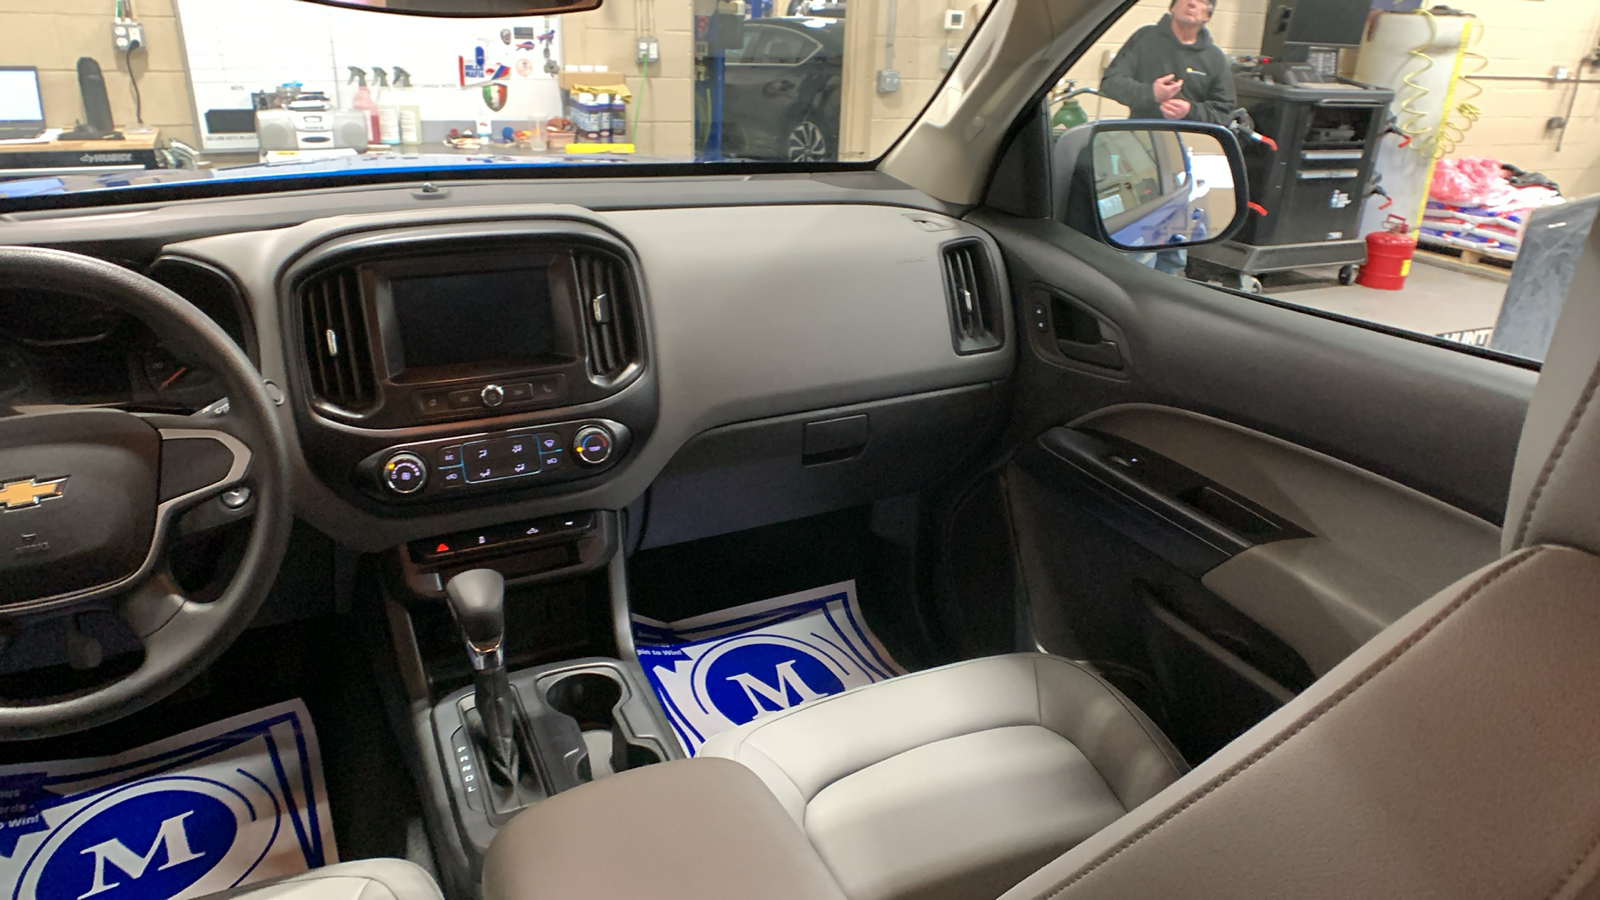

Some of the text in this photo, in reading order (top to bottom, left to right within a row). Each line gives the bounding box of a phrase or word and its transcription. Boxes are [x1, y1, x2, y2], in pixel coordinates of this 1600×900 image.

[93, 153, 133, 163] HUSKY
[636, 648, 651, 656] pin
[725, 659, 829, 720] M
[459, 755, 469, 763] R
[462, 764, 472, 772] N
[464, 774, 474, 782] D
[8, 814, 39, 828] Win!
[78, 810, 206, 900] M
